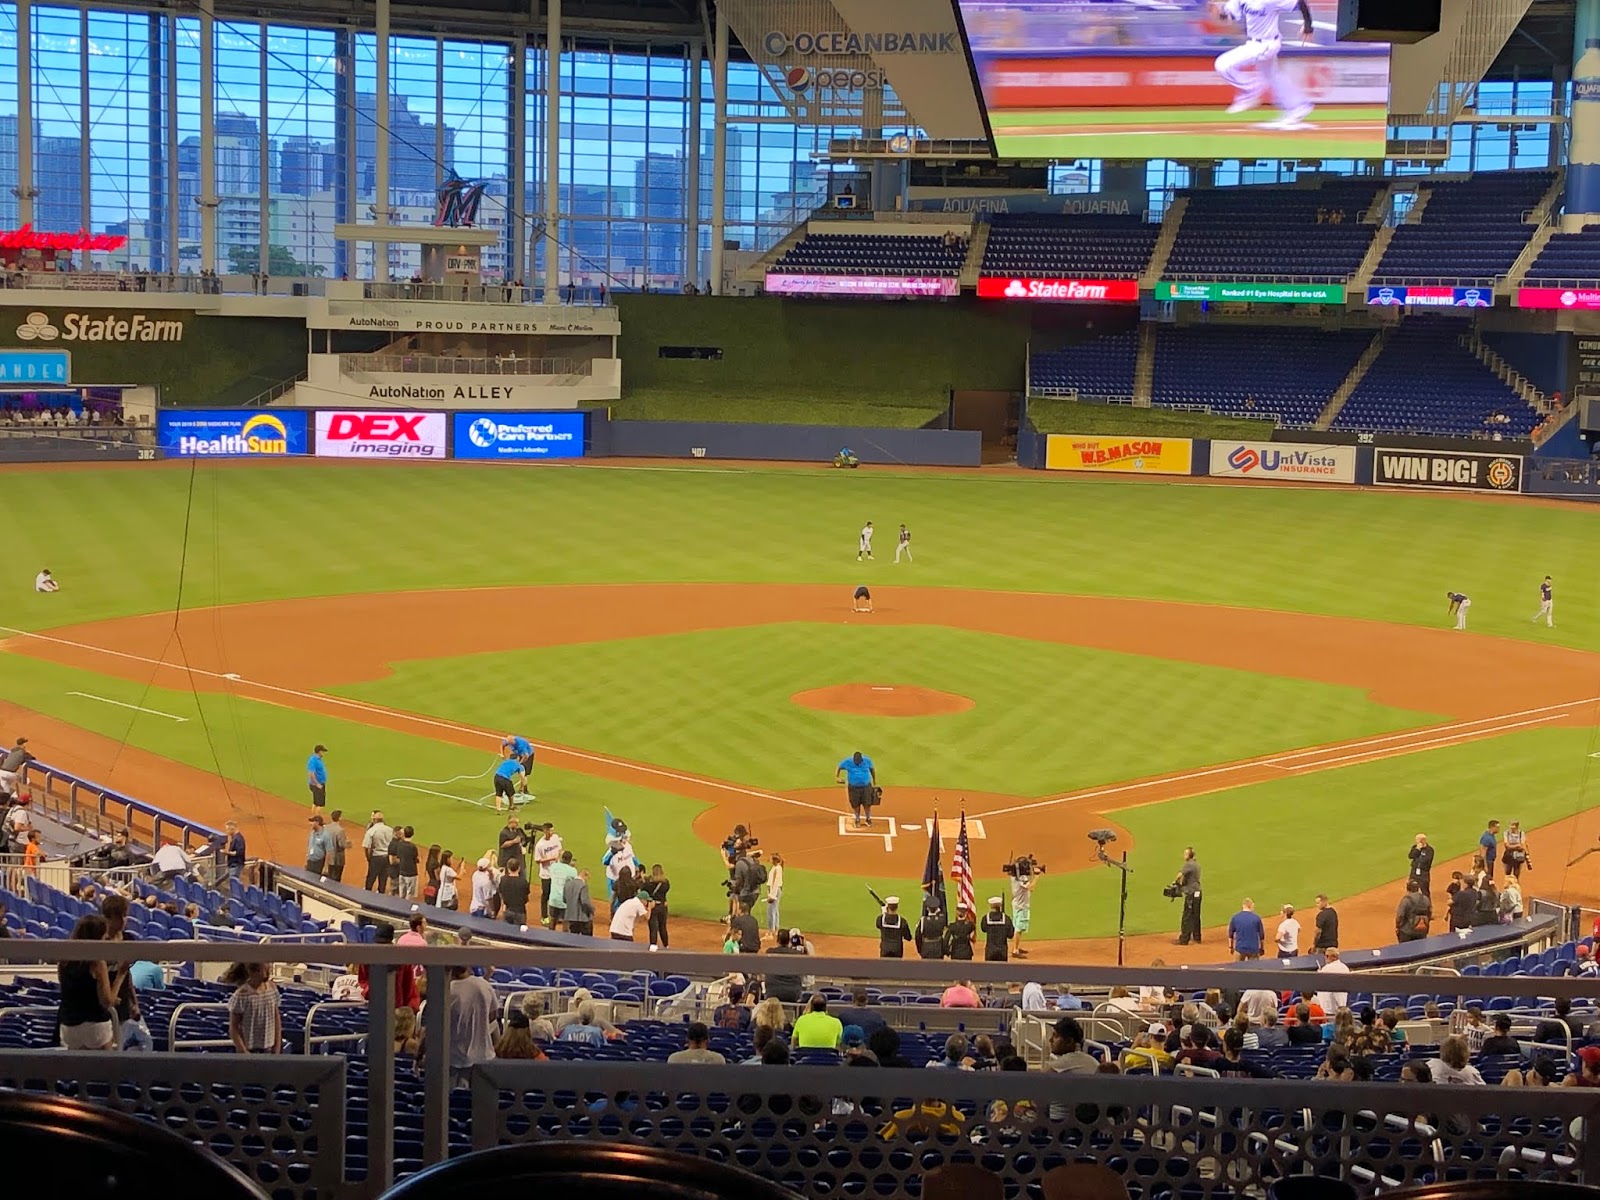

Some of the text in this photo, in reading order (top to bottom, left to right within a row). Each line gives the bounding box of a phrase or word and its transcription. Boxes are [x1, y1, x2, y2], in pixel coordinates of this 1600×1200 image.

[815, 67, 884, 92] pepsi
[892, 135, 908, 149] 42
[942, 198, 1009, 215] AQUAFINA
[1063, 199, 1130, 215] AQUAFINA
[1221, 289, 1245, 297] Ranked
[1246, 289, 1254, 297] #1
[1255, 290, 1267, 298] Eye
[1267, 290, 1294, 299] Hospital
[1294, 290, 1300, 298] in
[349, 317, 400, 328] AutoNation
[416, 320, 538, 332] PROUD PARTNERS
[369, 385, 514, 399] AutoNation ALLEY
[326, 414, 427, 441] DEX
[497, 424, 553, 433] Preferred
[497, 432, 573, 441] Care Partners
[1357, 433, 1374, 444] 392
[180, 434, 287, 454] HealthSun
[350, 441, 435, 456] imaging
[691, 447, 706, 457] 407
[1260, 450, 1336, 471] UniVista
[1280, 465, 1336, 475] INSURANCE
[1382, 455, 1428, 481] WIN
[1431, 458, 1478, 484] BIG!
